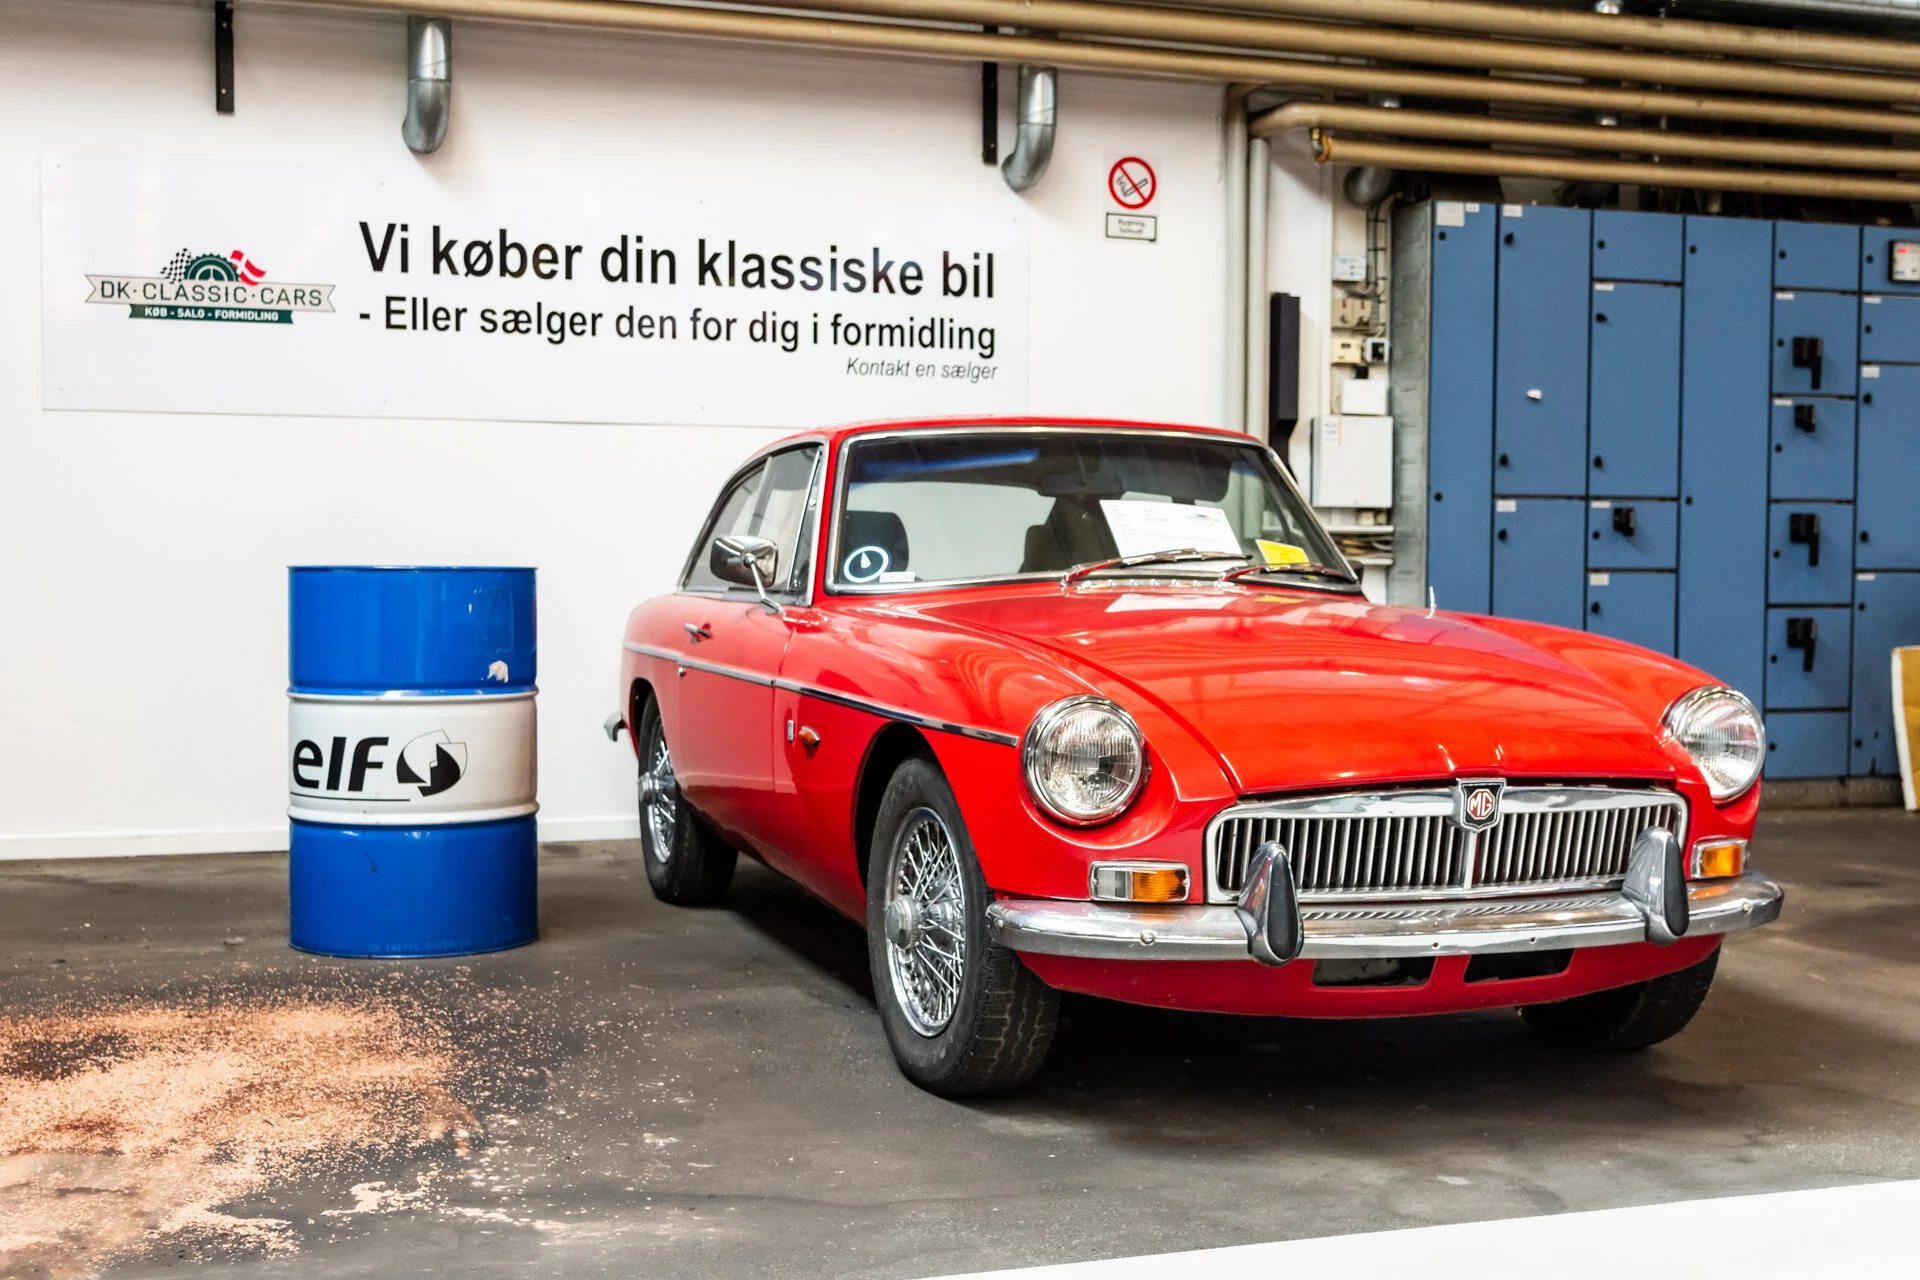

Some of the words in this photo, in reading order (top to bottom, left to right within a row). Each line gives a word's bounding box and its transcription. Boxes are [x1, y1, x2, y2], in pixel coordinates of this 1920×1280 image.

[358, 221, 409, 274] Vi
[432, 225, 583, 280] køber
[600, 234, 676, 285] din
[698, 238, 924, 296] klassiske
[942, 250, 994, 298] bil
[101, 280, 130, 300] DK
[142, 283, 248, 304] CLASSIC
[259, 286, 323, 307] CARS
[144, 304, 168, 318] KØB
[177, 306, 205, 319] SALG
[214, 308, 279, 322] FORMIDLING
[385, 295, 468, 332] Eller
[480, 301, 603, 345] sælger
[615, 305, 678, 340] den
[690, 307, 738, 342] for
[748, 310, 799, 353] dig
[812, 312, 819, 345] i
[830, 313, 995, 359] formidling
[846, 357, 910, 377] Kontakt
[915, 363, 936, 378] en
[941, 361, 998, 384] sælger
[1469, 791, 1494, 817] MG
